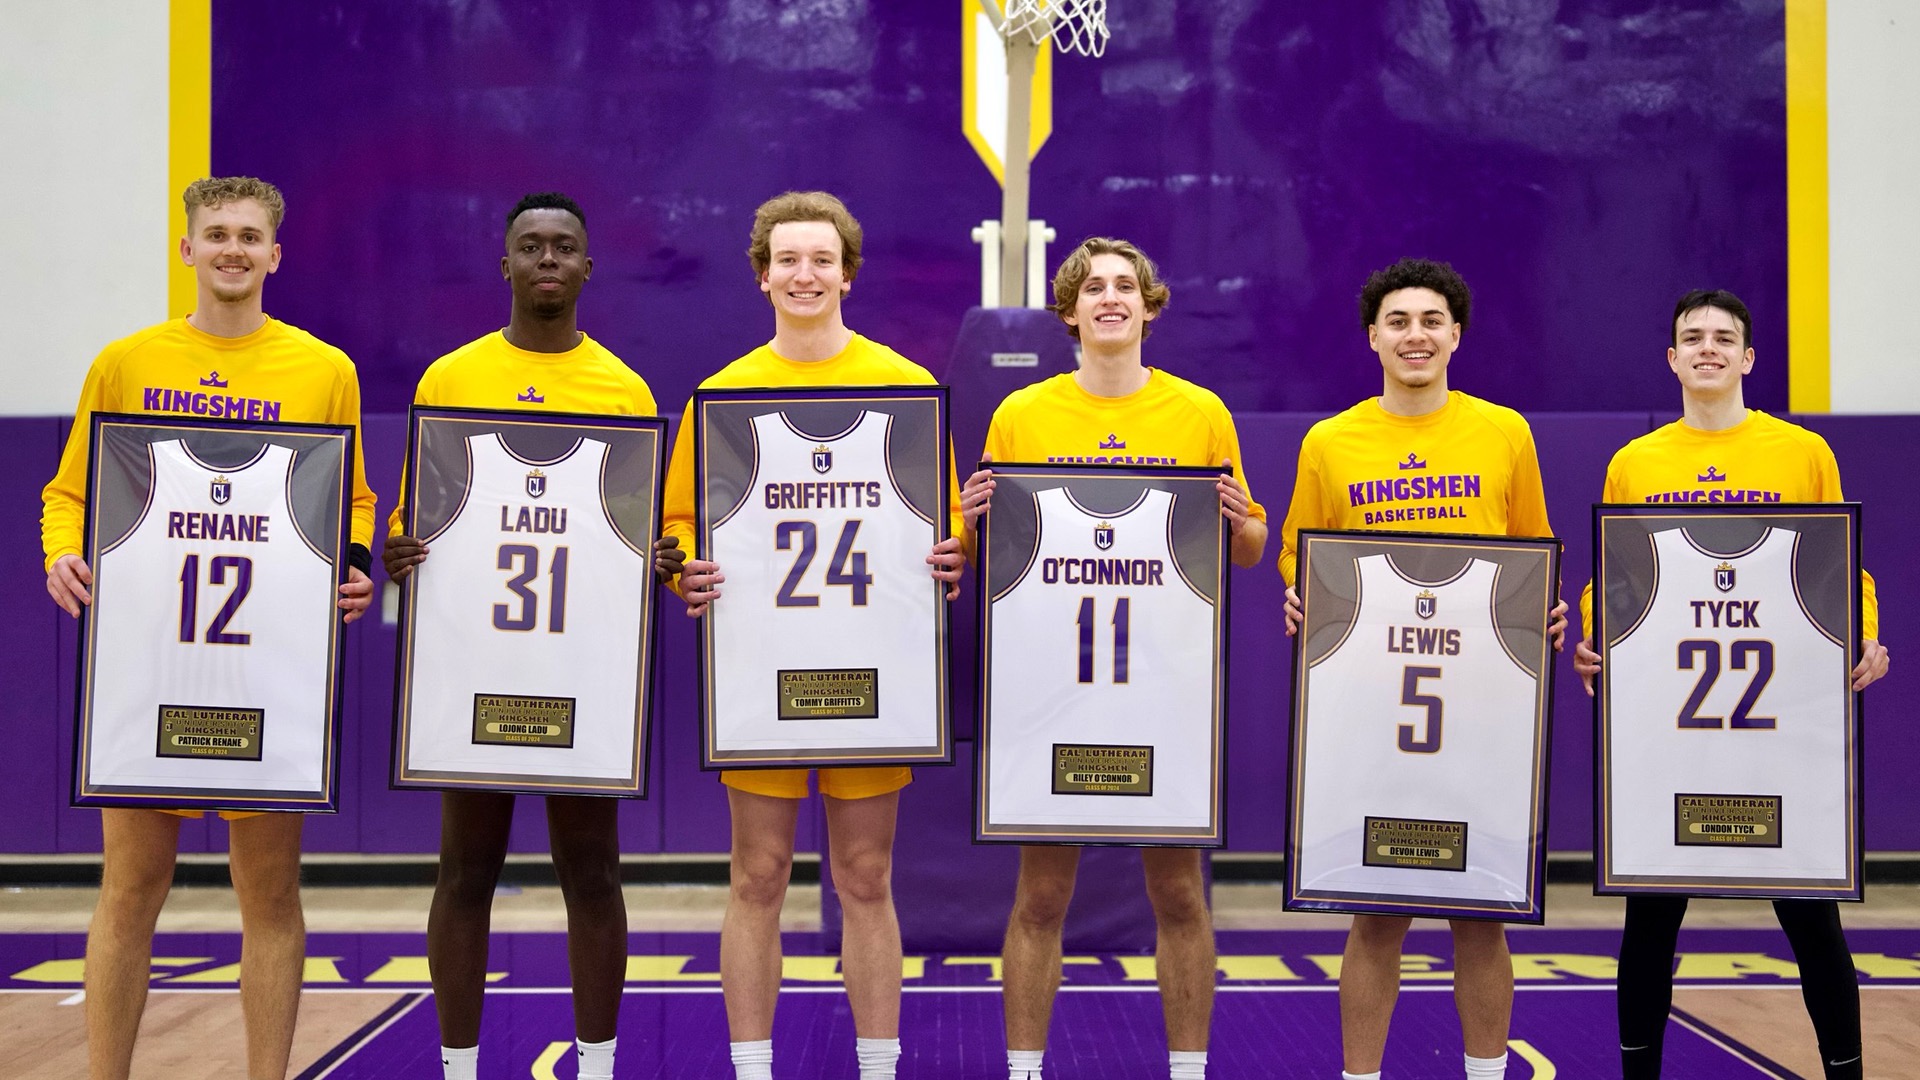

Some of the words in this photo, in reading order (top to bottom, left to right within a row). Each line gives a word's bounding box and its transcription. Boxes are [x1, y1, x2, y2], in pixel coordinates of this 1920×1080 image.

[144, 388, 281, 422] KINGSMEN
[765, 481, 881, 509] GRIFFITTS
[1348, 475, 1481, 507] KINGSMEN
[1645, 490, 1781, 503] GSME
[501, 505, 568, 534] LADU
[1365, 506, 1466, 525] BASKETBALL
[168, 512, 269, 542] RENANE
[774, 519, 874, 608] 24
[1042, 557, 1164, 586] O'CONNOR
[492, 542, 570, 634] 31
[178, 552, 254, 646] 12
[1690, 601, 1760, 628] TYCK
[1075, 596, 1131, 684] 11
[1387, 625, 1461, 656] LEWIS
[810, 673, 871, 681] LUTHERAN
[1676, 638, 1778, 730] 22
[481, 699, 502, 707] CAL
[507, 700, 568, 710] LUTHERAN
[795, 699, 823, 707] TOMMY
[824, 698, 861, 706] GRIFFITTS
[166, 711, 188, 719] CAL
[193, 712, 257, 721] LUTHERAN
[1397, 665, 1443, 755] 5
[499, 715, 549, 723] KINGSMEN
[184, 727, 236, 735] KINGSMEN
[499, 724, 526, 733] LOJONG
[528, 725, 548, 734] LADU
[178, 736, 211, 746] PATRICK
[212, 737, 242, 747] RENANE
[1060, 749, 1080, 757] CAL
[1086, 750, 1146, 758] LUTHERAN
[1073, 774, 1093, 782] RILEY
[1094, 774, 1132, 783] O'CONNOR
[1682, 799, 1704, 807] CAL
[1710, 799, 1773, 808] LUTHERAN
[1371, 821, 1392, 829] CAL
[1398, 823, 1460, 833] LUTHERAN
[1701, 824, 1732, 833] LONDON
[1734, 825, 1754, 833] TYCK
[1390, 838, 1440, 846] KINGSMEN
[1390, 847, 1414, 856] DEVON
[1416, 848, 1440, 857] LEWIS
